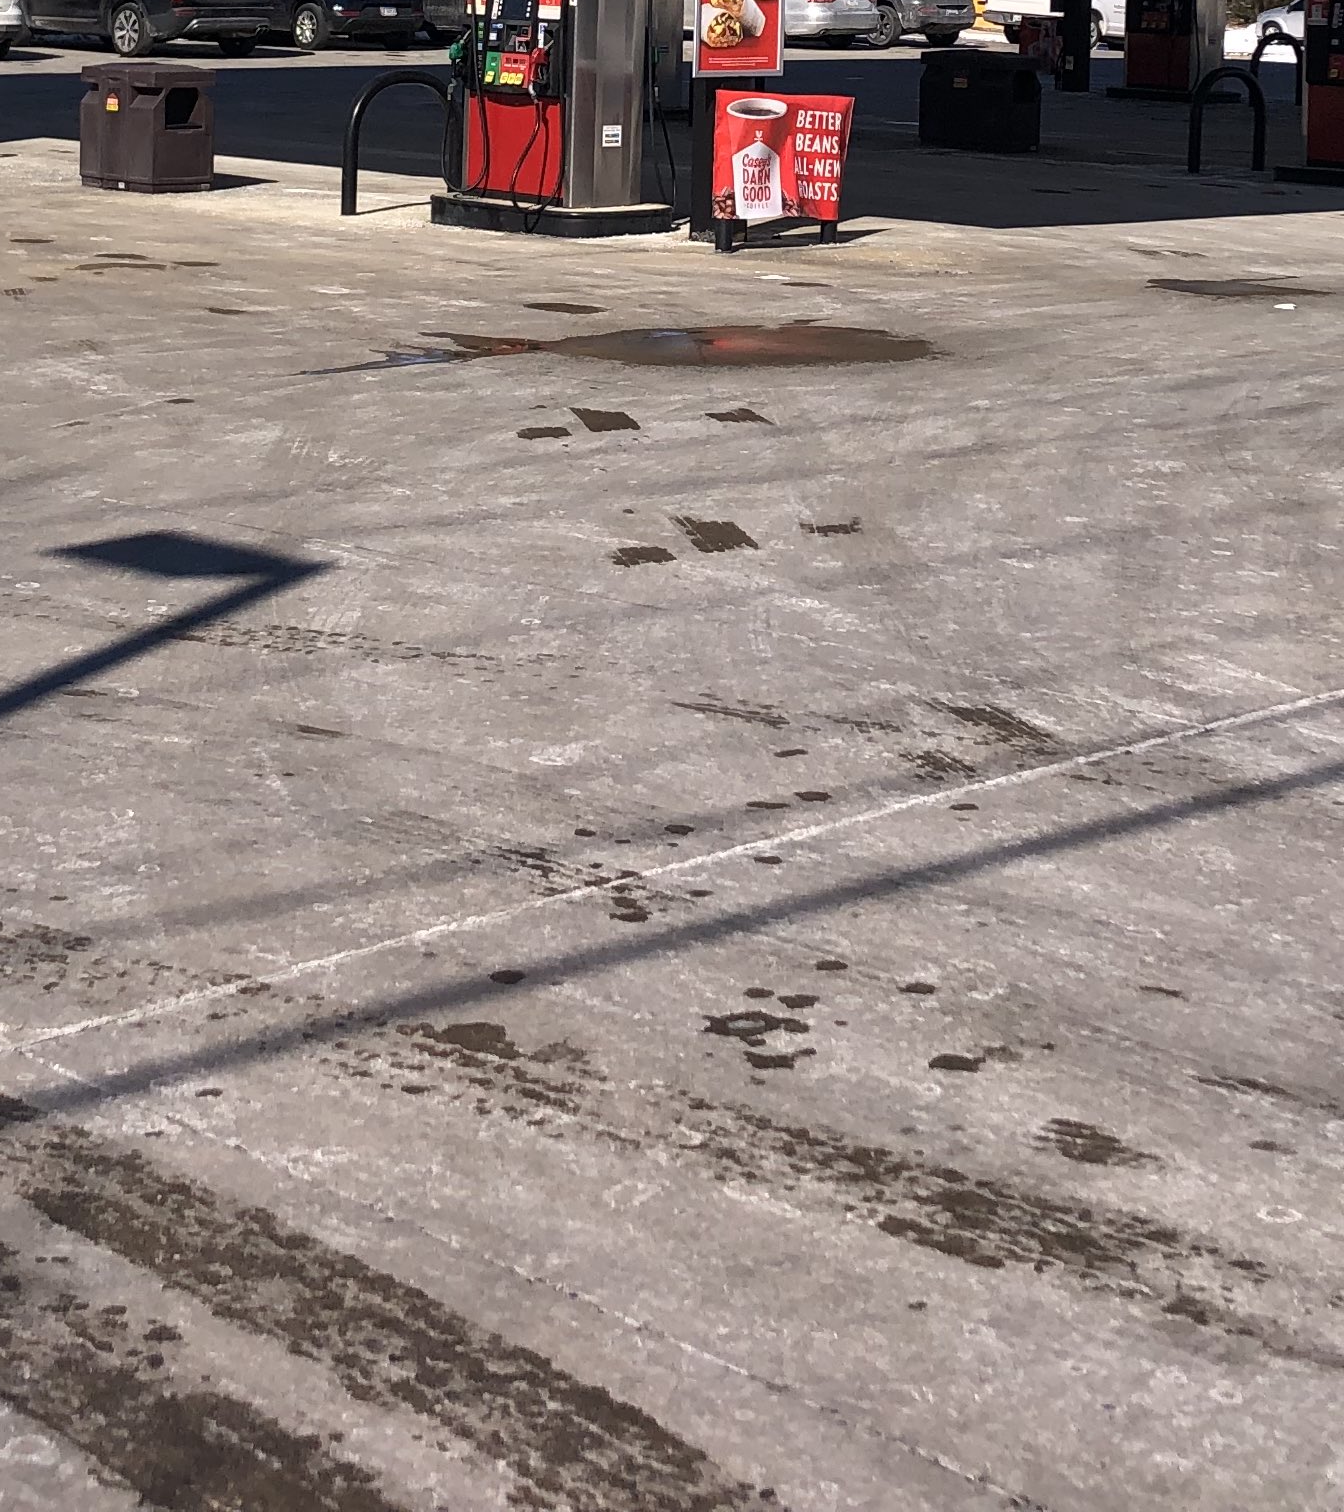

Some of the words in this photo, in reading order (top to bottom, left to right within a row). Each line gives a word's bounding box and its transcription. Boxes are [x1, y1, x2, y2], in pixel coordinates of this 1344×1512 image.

[795, 109, 843, 131] BETTER
[795, 133, 841, 155] BEANS.
[741, 153, 773, 171] Casey's
[742, 168, 772, 186] DARN
[742, 186, 772, 203] GOOD
